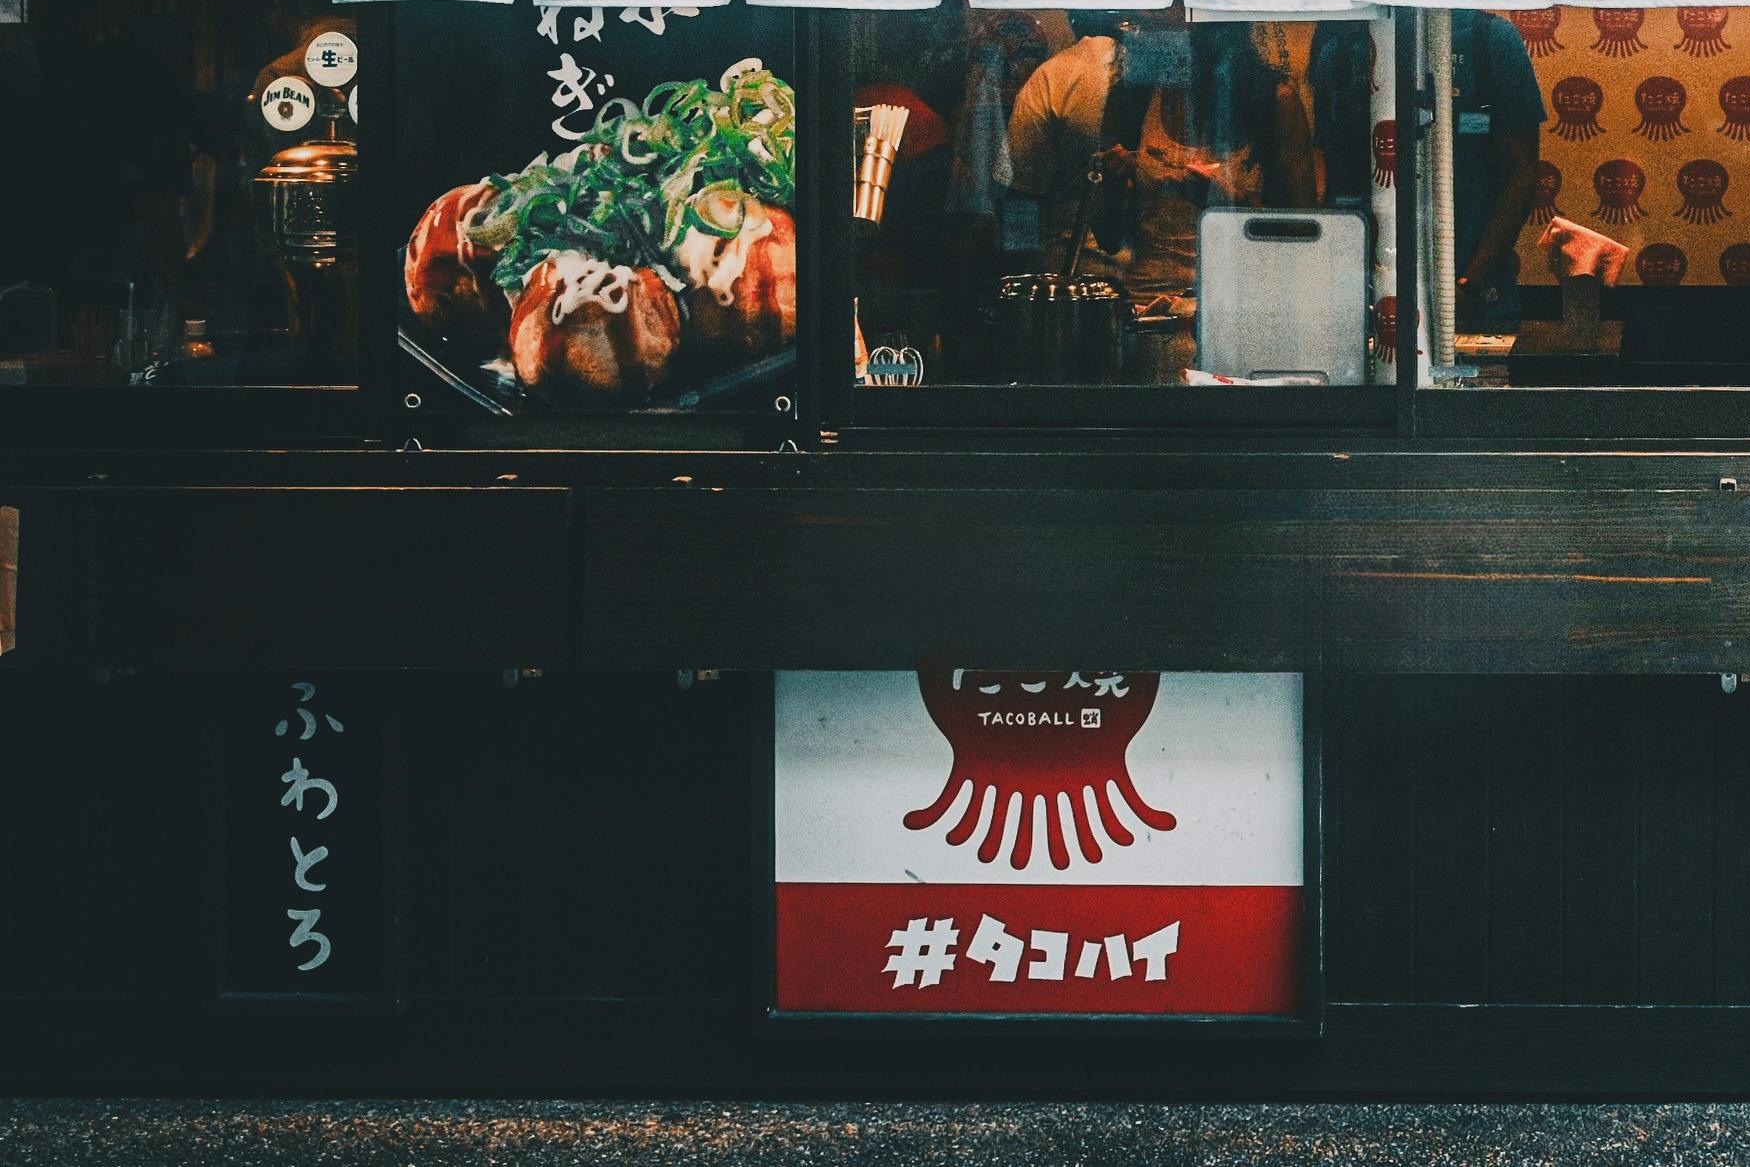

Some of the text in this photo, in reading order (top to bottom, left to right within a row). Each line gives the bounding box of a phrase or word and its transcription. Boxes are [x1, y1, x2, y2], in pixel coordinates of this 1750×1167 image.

[263, 86, 310, 108] JIM BEAM
[977, 711, 1075, 726] TACOBALL
[275, 682, 344, 972] ふわとろ
